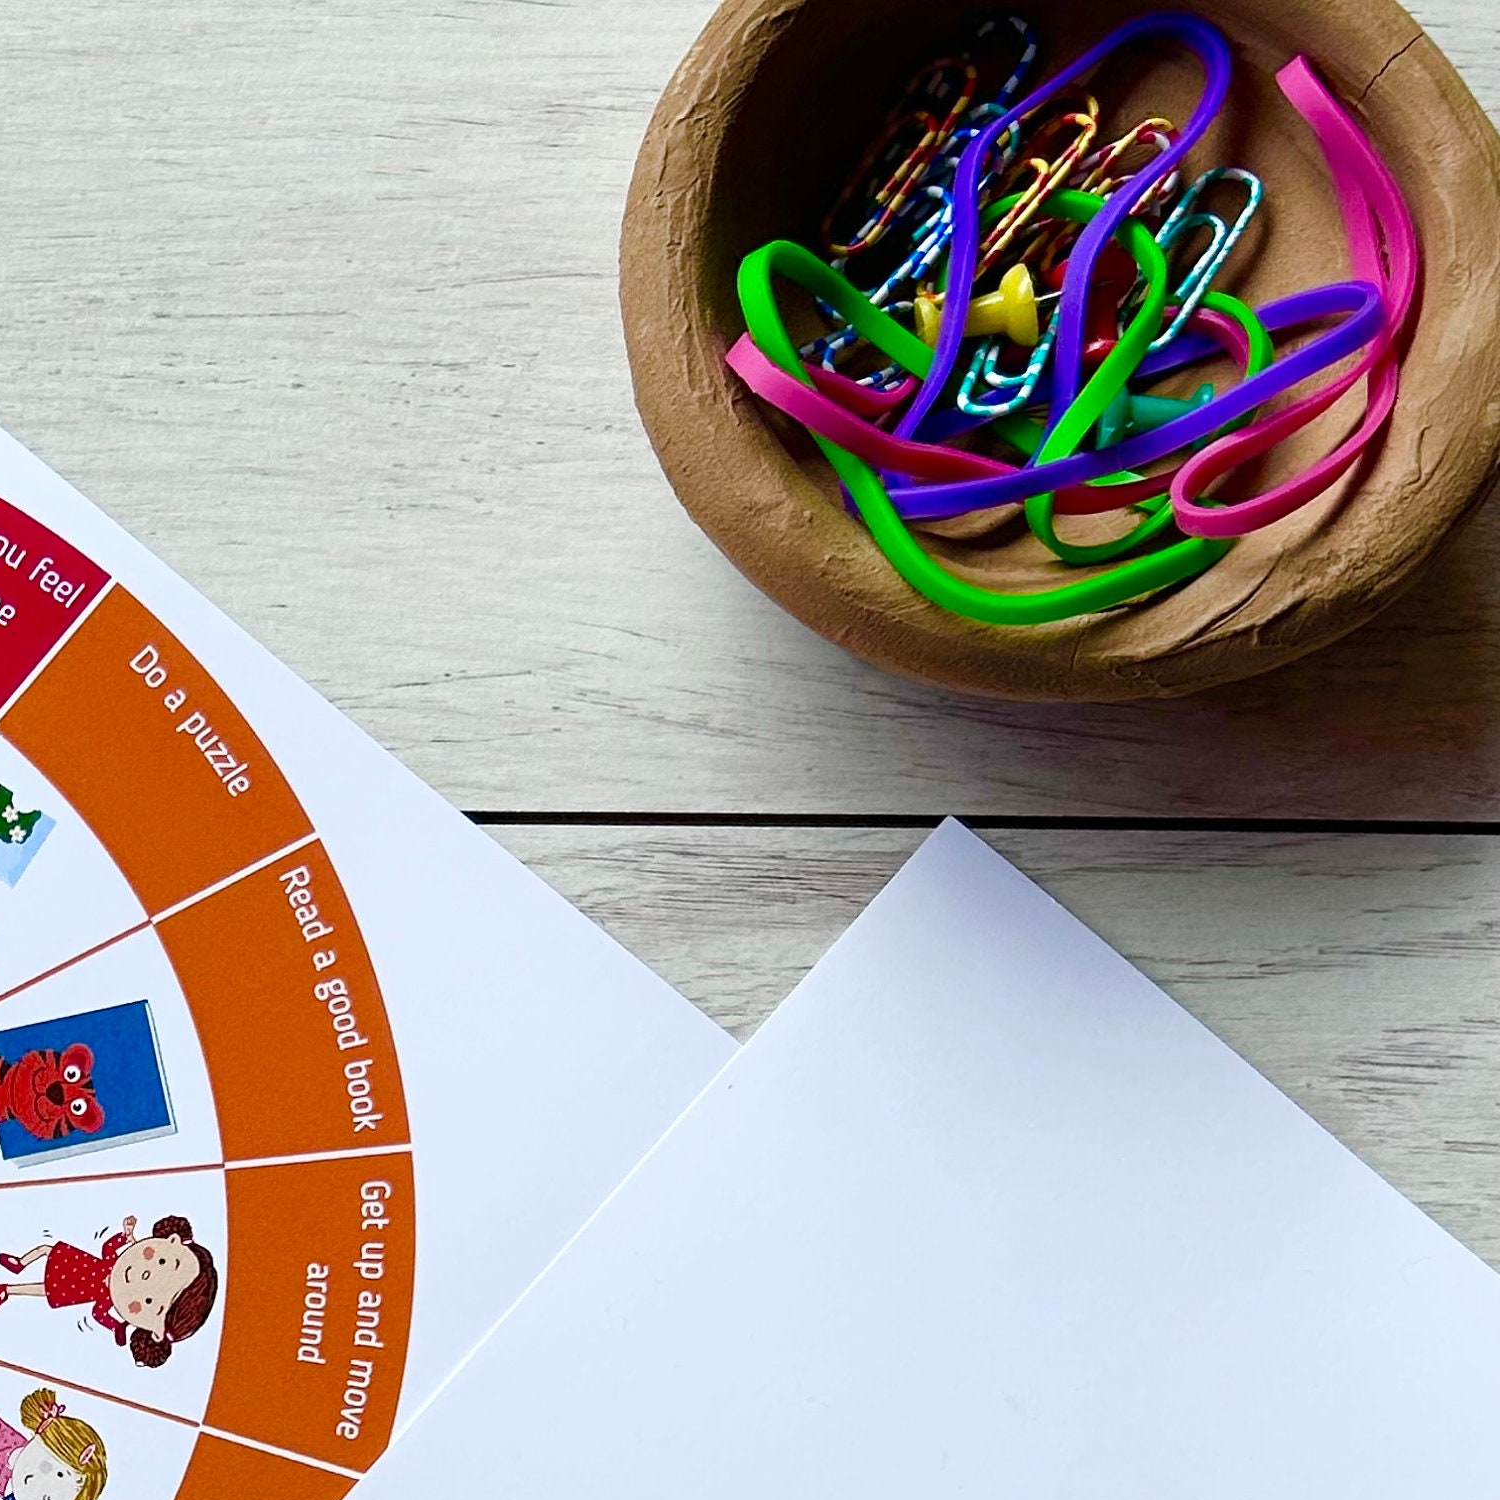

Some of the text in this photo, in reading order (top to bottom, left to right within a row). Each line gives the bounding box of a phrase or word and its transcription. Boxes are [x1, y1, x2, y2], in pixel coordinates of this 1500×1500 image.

[29, 558, 86, 609] feel
[129, 644, 252, 798] Do a puzzle
[279, 864, 383, 1133] Read a good book
[296, 1262, 329, 1365] around
[335, 1180, 392, 1441] Get up and move
